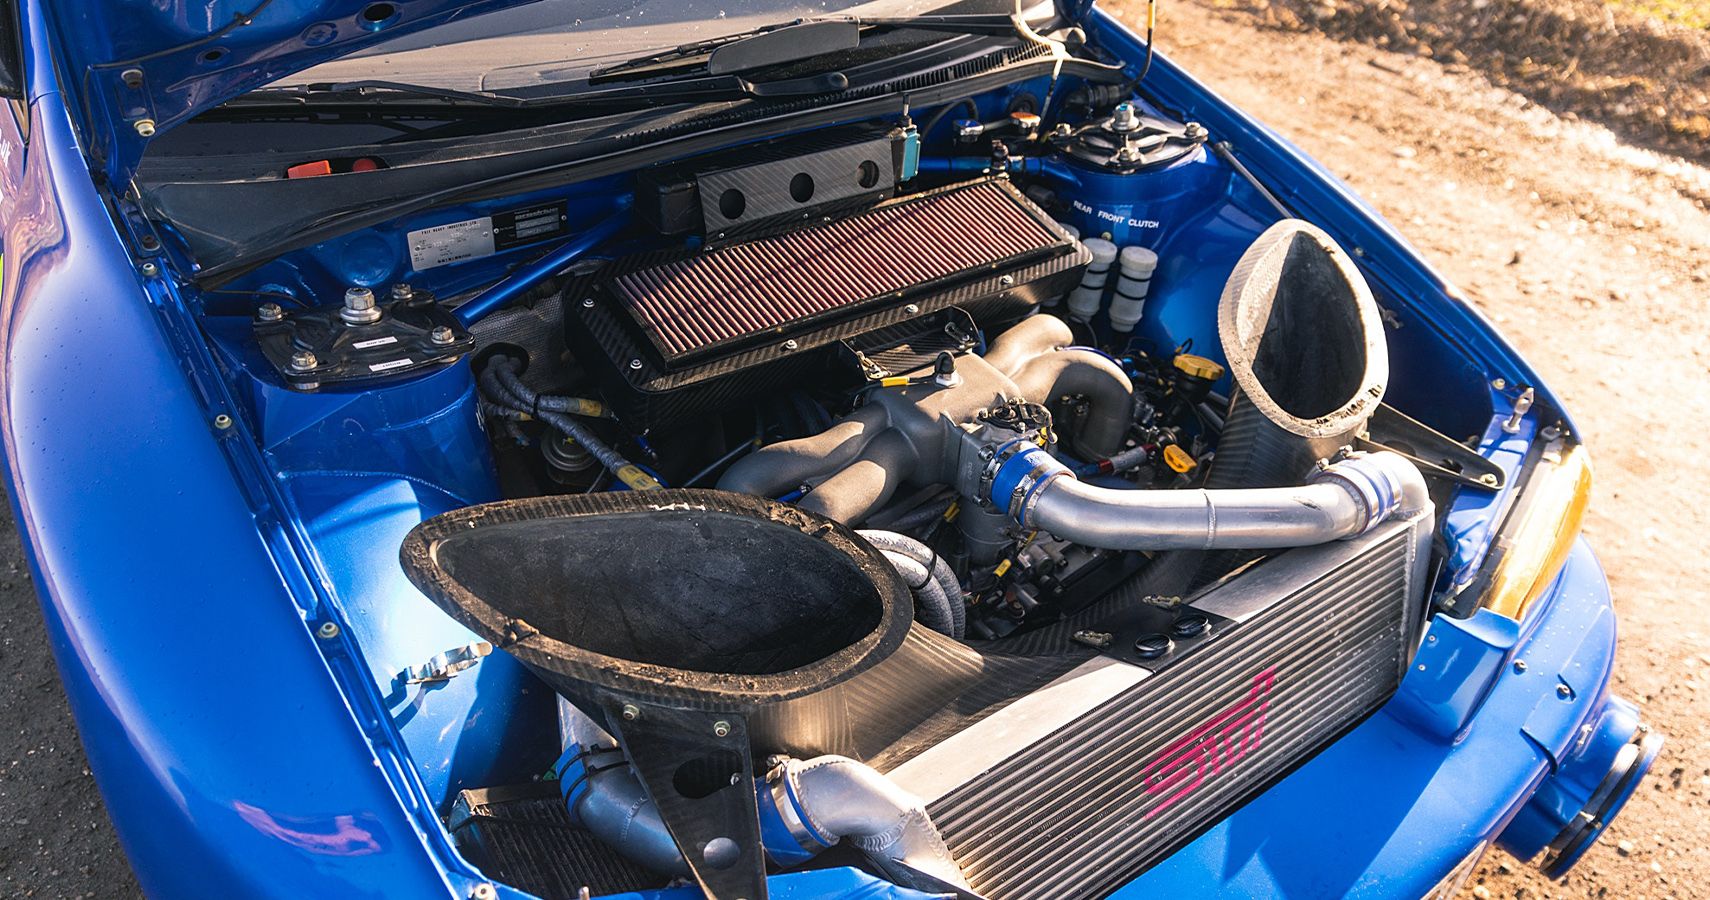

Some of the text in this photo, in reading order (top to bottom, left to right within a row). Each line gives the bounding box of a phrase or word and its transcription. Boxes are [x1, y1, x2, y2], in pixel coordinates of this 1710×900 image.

[1073, 200, 1160, 229] REAR FRONT CLUTCH
